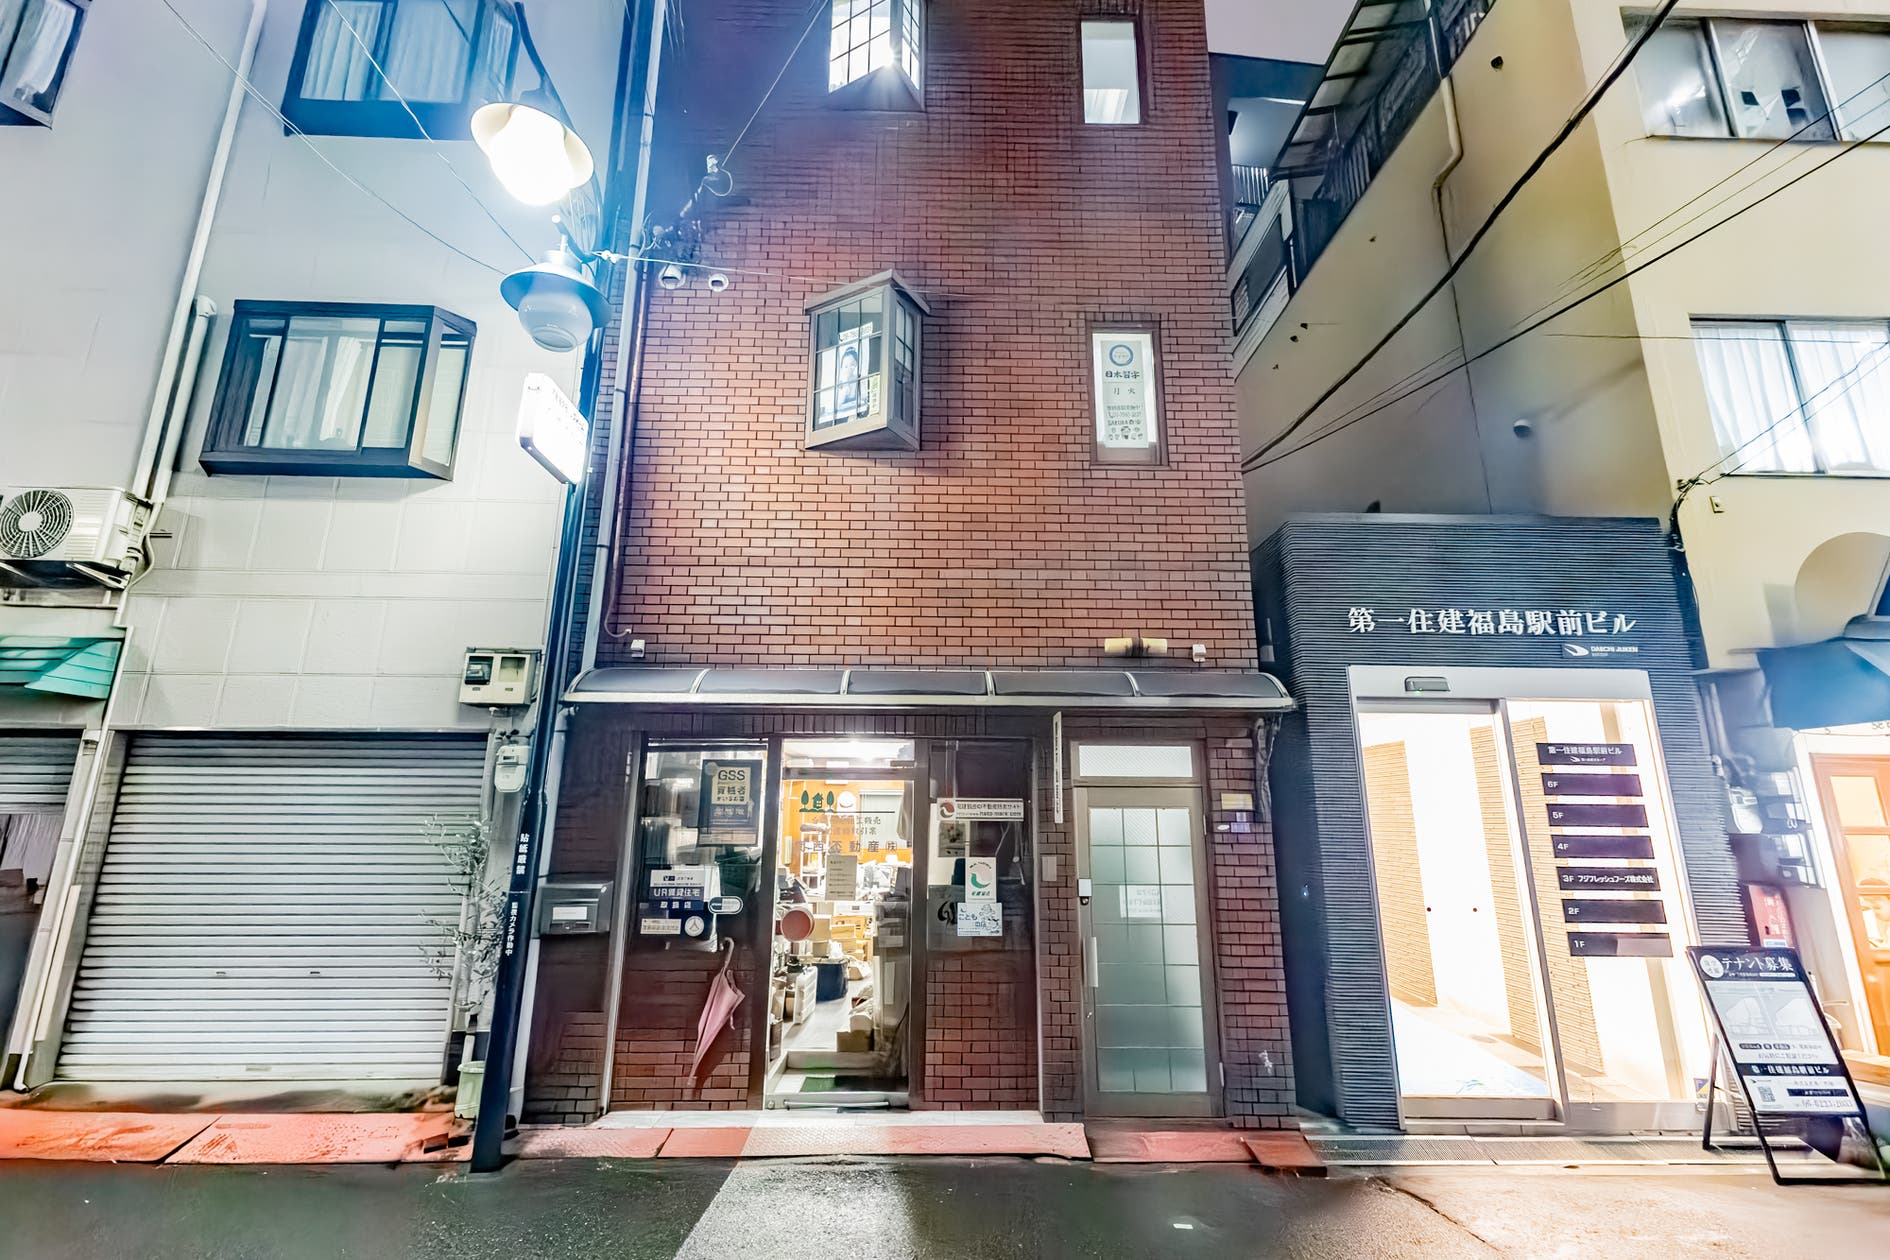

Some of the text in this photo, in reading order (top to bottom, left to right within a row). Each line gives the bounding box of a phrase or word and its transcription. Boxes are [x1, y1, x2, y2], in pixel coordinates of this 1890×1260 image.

[1105, 370, 1140, 379] 日本習字
[1348, 607, 1638, 636] 第一住建福島駅前ビル
[718, 769, 746, 781] GSS
[1547, 780, 1559, 788] 6F
[1552, 811, 1564, 819] 5F
[1557, 842, 1569, 850] 4F
[1562, 874, 1574, 882] 3F
[1567, 907, 1580, 915] 2F
[1574, 940, 1585, 948] 1F
[1721, 956, 1794, 972] テナント募集
